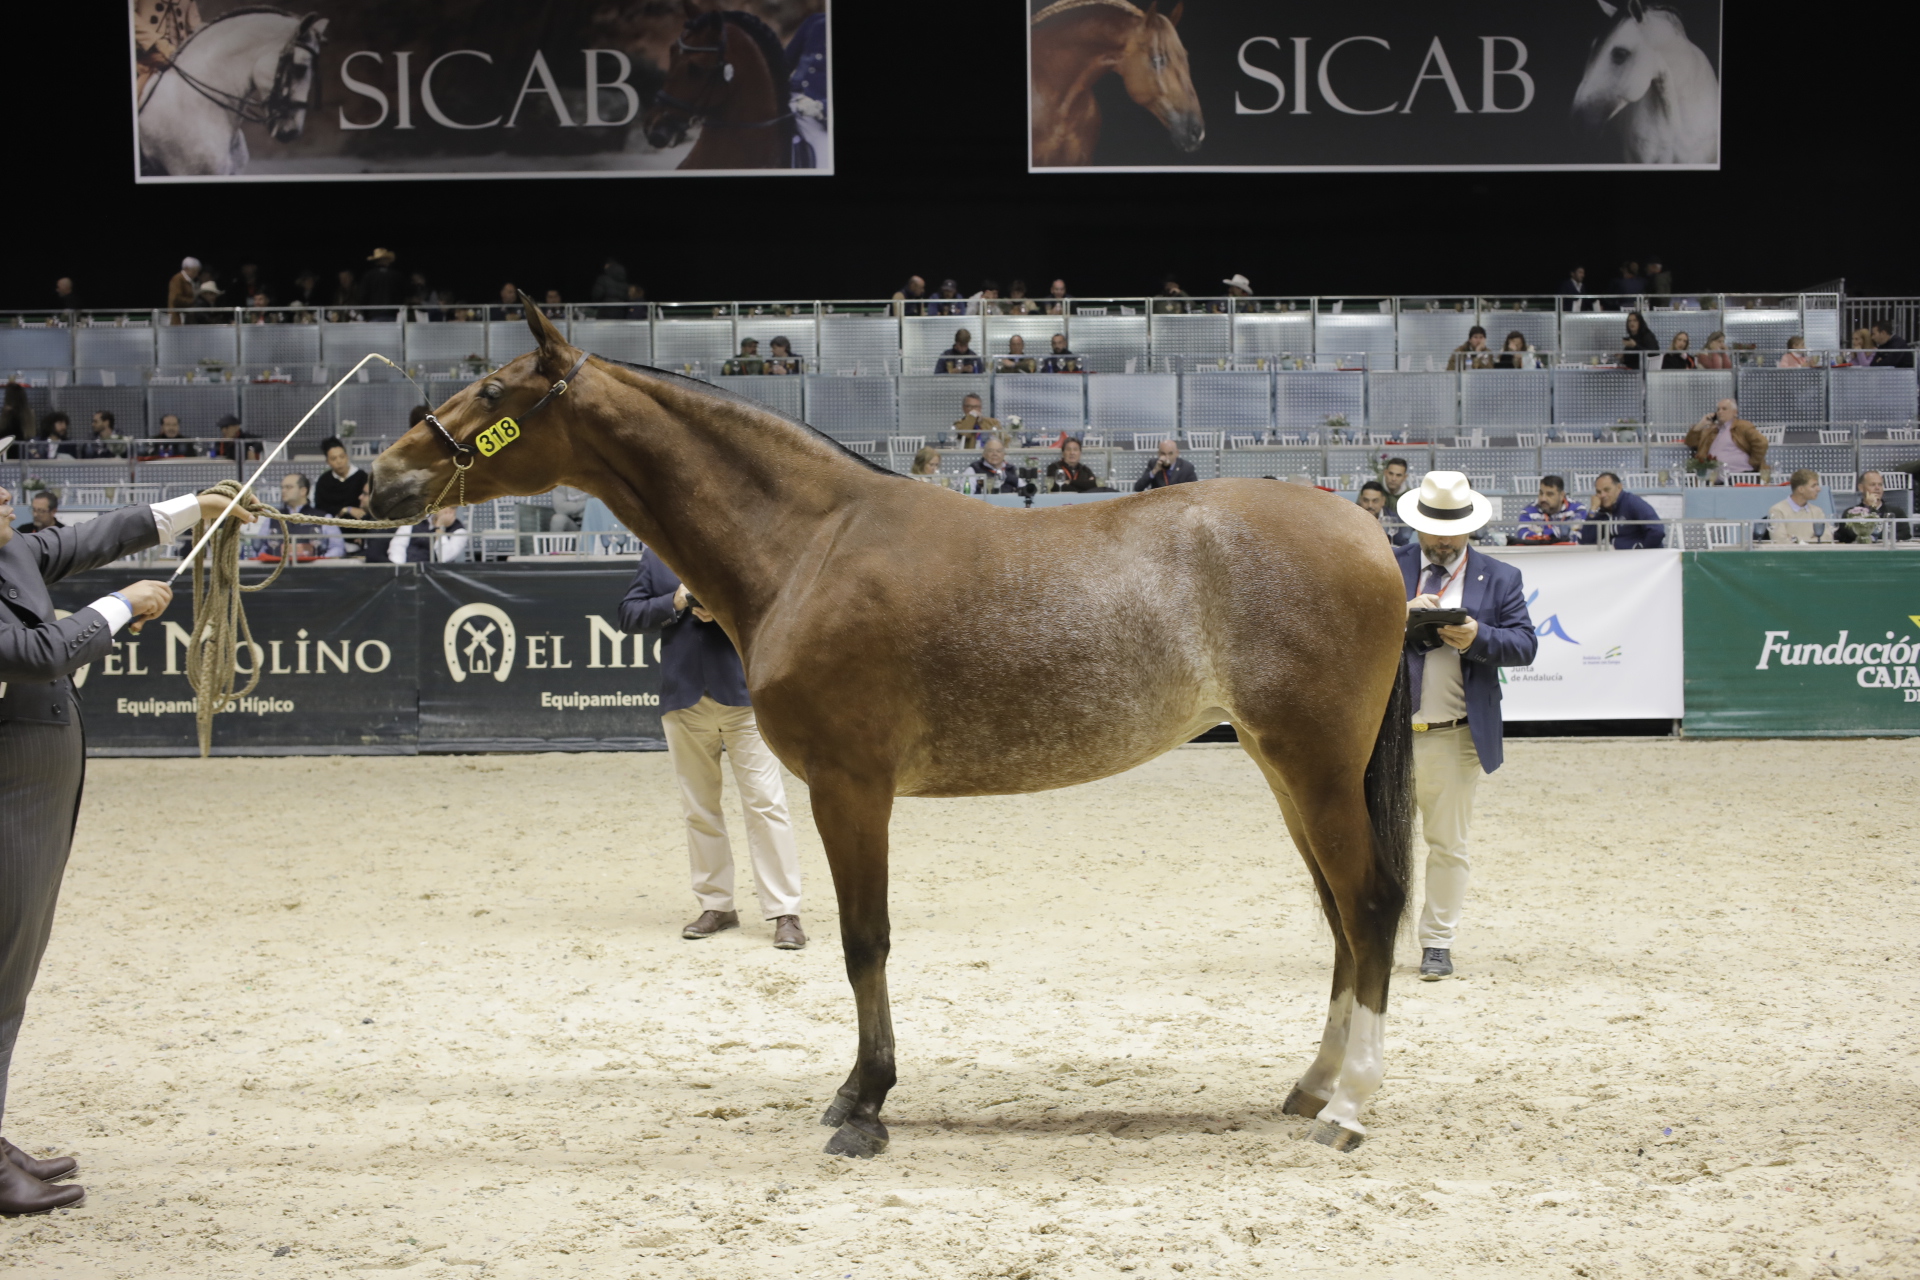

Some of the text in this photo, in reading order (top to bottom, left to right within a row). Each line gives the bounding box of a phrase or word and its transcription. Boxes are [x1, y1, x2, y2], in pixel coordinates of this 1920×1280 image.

[339, 49, 640, 130] SICAB
[1235, 35, 1535, 115] SICAB
[479, 419, 517, 453] 318
[101, 640, 149, 676] EL
[525, 635, 572, 669] EL
[1755, 630, 1920, 670] Fundación
[1523, 672, 1563, 681] Andalucía
[1856, 666, 1920, 690] CAJA
[239, 696, 294, 716] Hípico
[541, 691, 660, 711] Equipamiento
